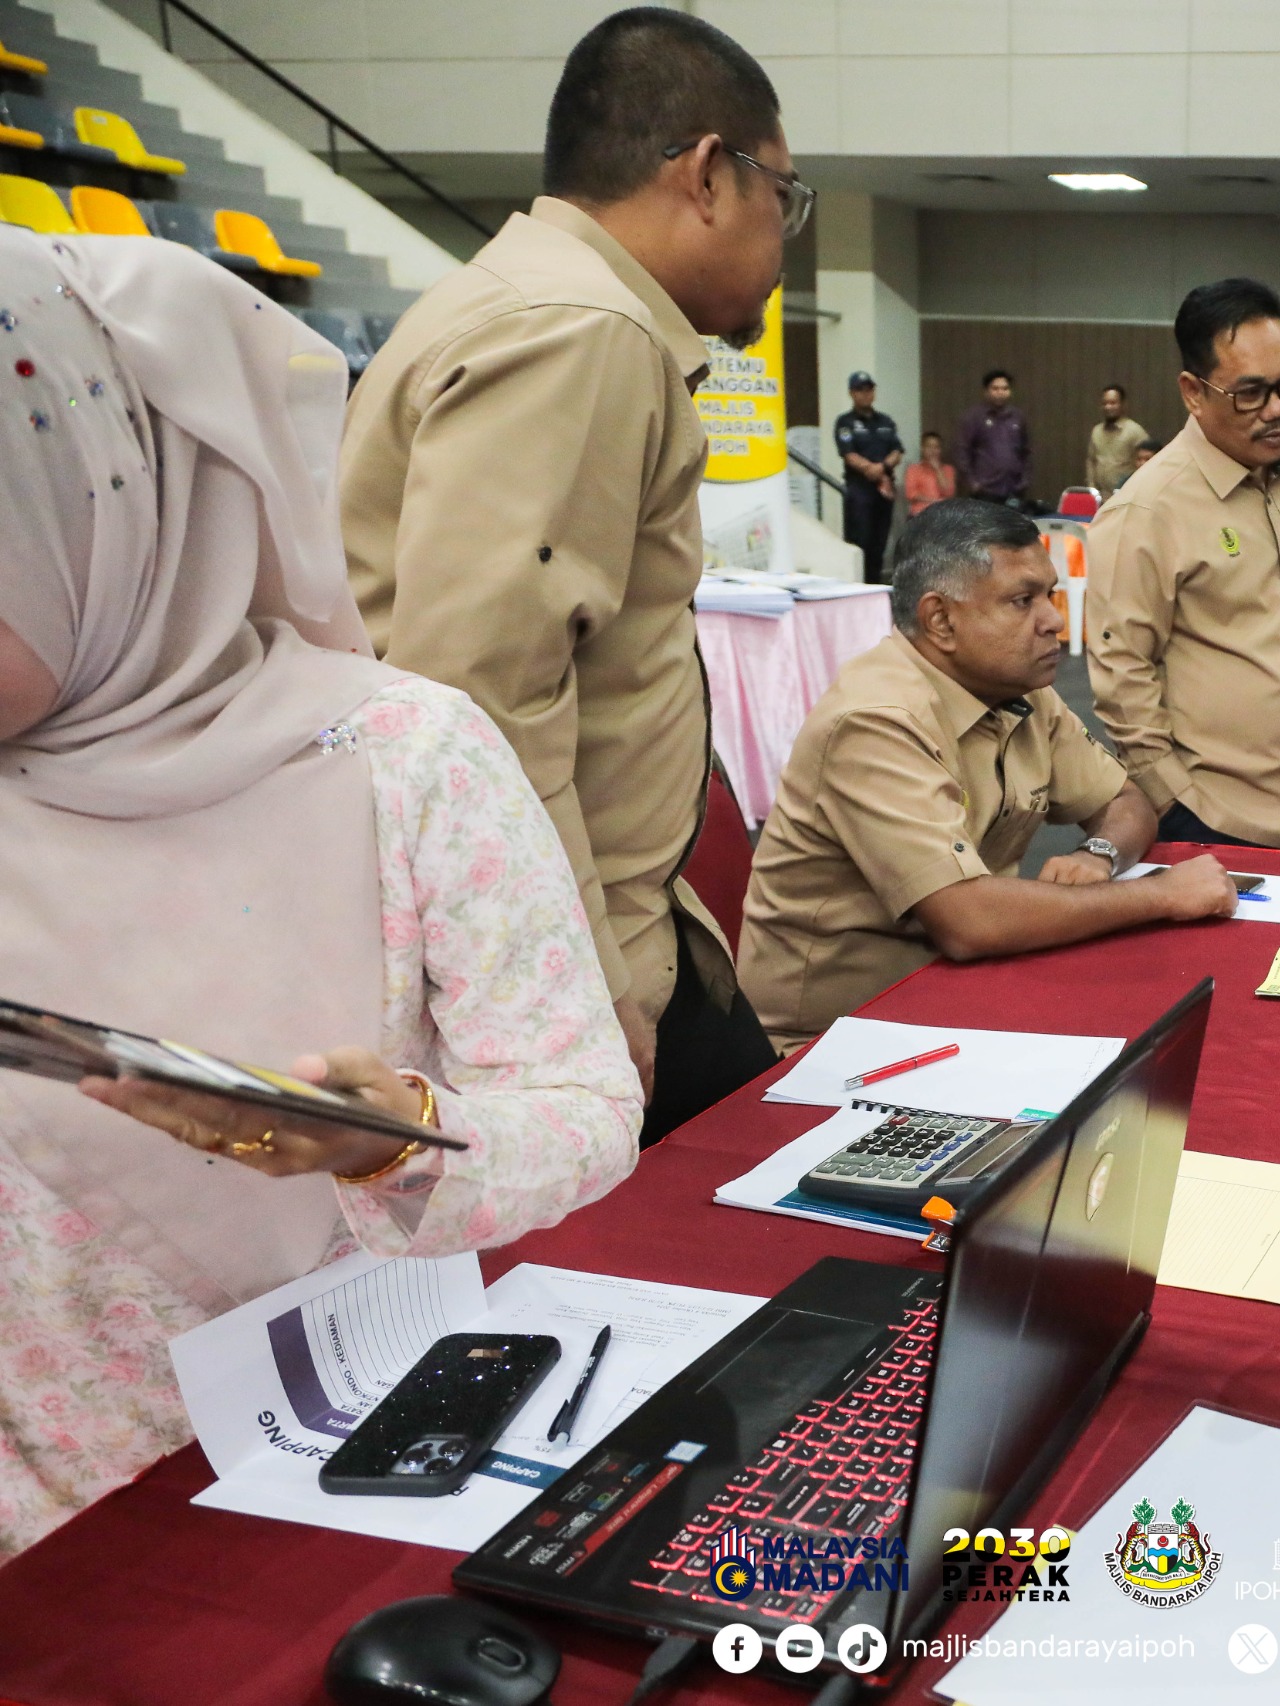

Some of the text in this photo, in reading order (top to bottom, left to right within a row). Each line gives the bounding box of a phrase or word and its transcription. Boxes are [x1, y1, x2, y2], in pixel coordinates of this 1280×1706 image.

[699, 400, 754, 414] MAJLIS
[327, 1313, 345, 1364] KEDIAMAN
[491, 1461, 541, 1478] CAPPING
